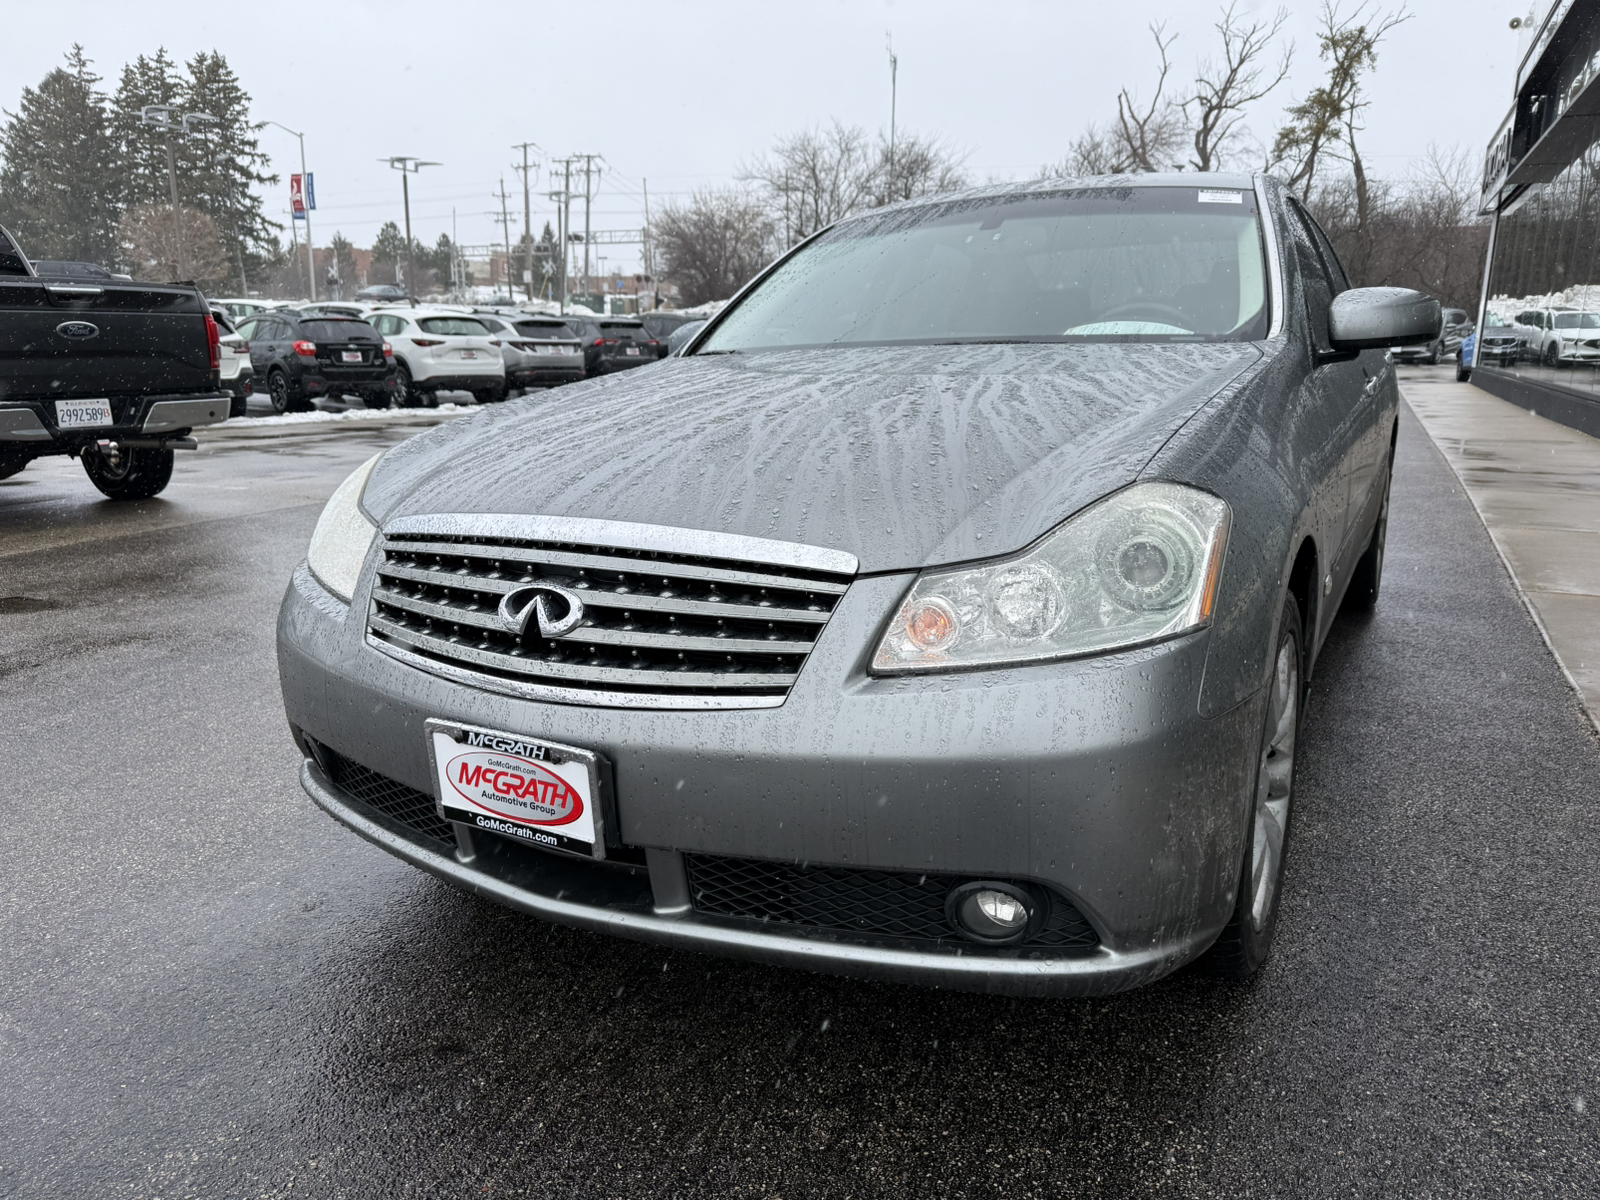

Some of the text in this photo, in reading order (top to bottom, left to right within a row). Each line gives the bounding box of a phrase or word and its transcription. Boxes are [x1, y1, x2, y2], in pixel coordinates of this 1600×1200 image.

[67, 324, 90, 335] Ford
[487, 758, 537, 776] GoMcGrath.com
[481, 790, 556, 816] Automotive Group
[476, 815, 558, 846] GoMcGrath.com
